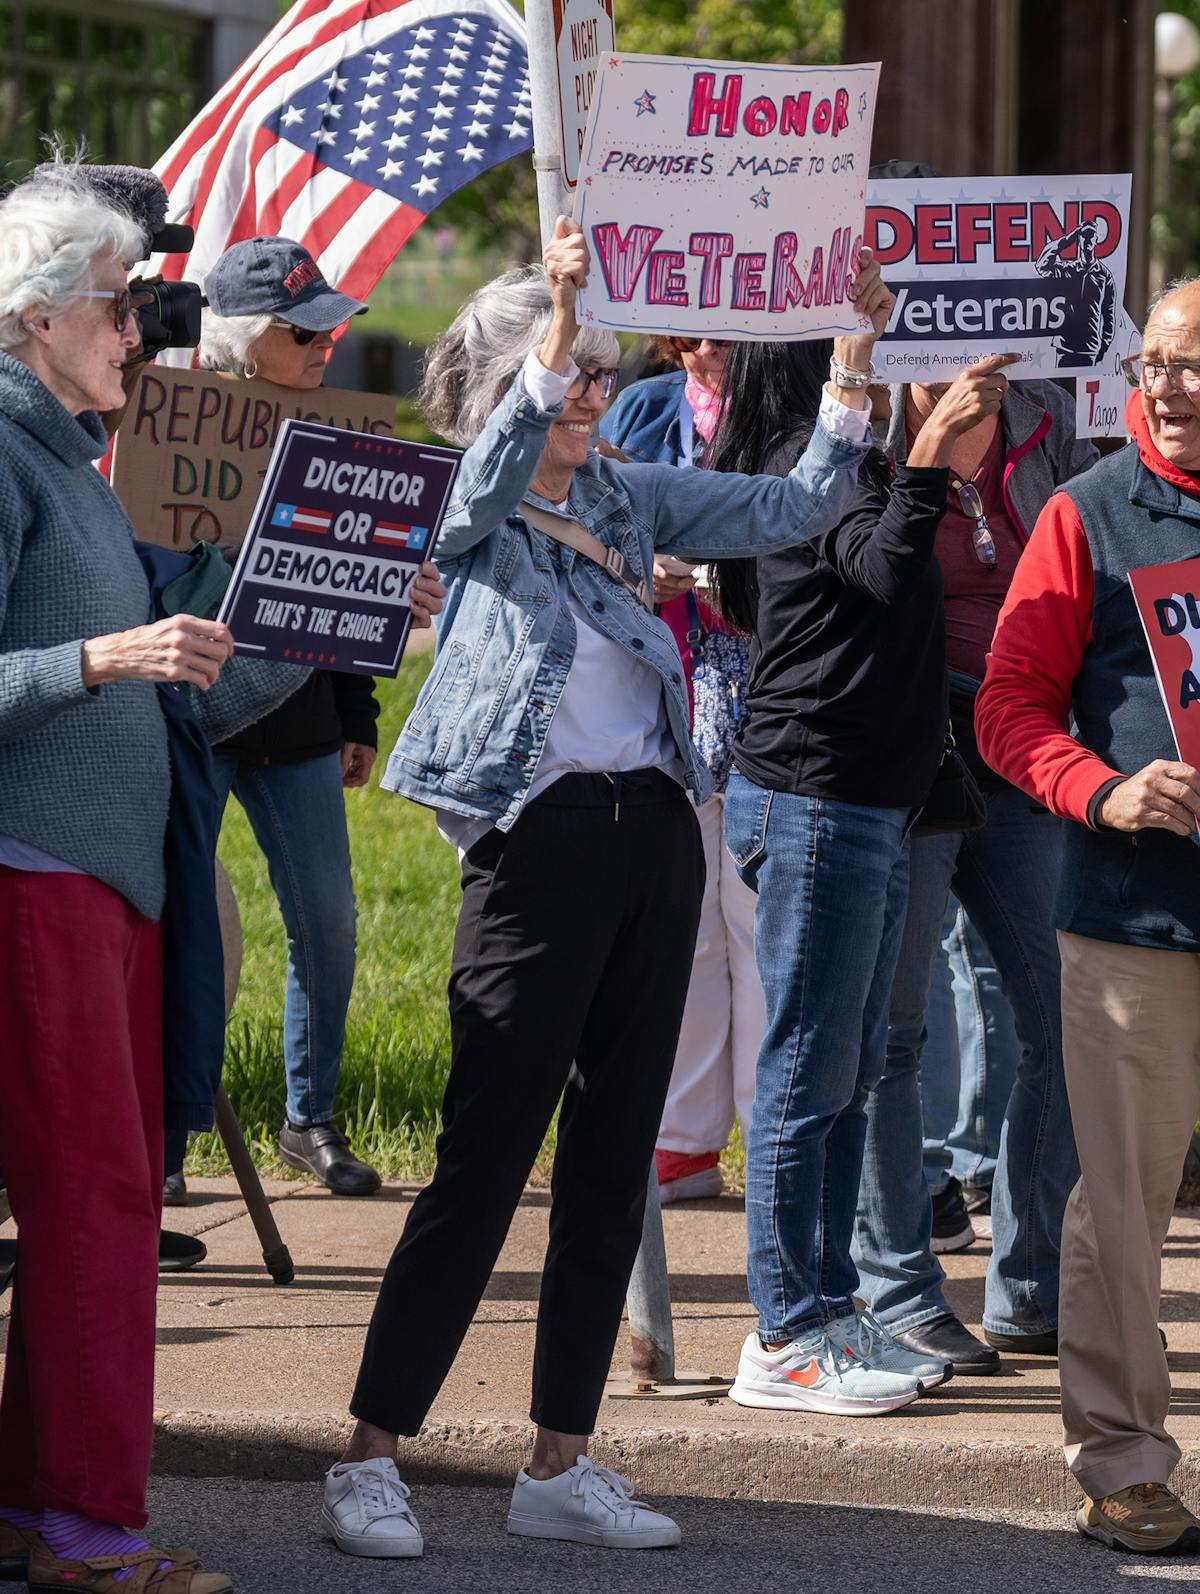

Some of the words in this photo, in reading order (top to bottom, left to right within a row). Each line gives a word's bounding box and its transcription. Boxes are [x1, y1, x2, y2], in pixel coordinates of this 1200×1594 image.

[571, 18, 598, 62] NIGHT
[575, 71, 597, 113] PLO
[687, 72, 849, 137] HONOR
[602, 151, 715, 176] PROMISES
[727, 155, 803, 176] MADE
[807, 156, 825, 176] TO
[832, 153, 855, 174] OUR
[866, 200, 1122, 266] DEFEND
[885, 289, 1066, 334] Veterans
[886, 353, 931, 366] Defend
[173, 454, 242, 501] DID
[303, 457, 425, 507] DICTATOR
[161, 504, 222, 545] TO
[333, 510, 373, 544] OR
[252, 546, 416, 599] DEMOCRACY
[254, 598, 306, 630] THAT'S
[307, 607, 337, 635] THE
[336, 613, 389, 643] CHOICE
